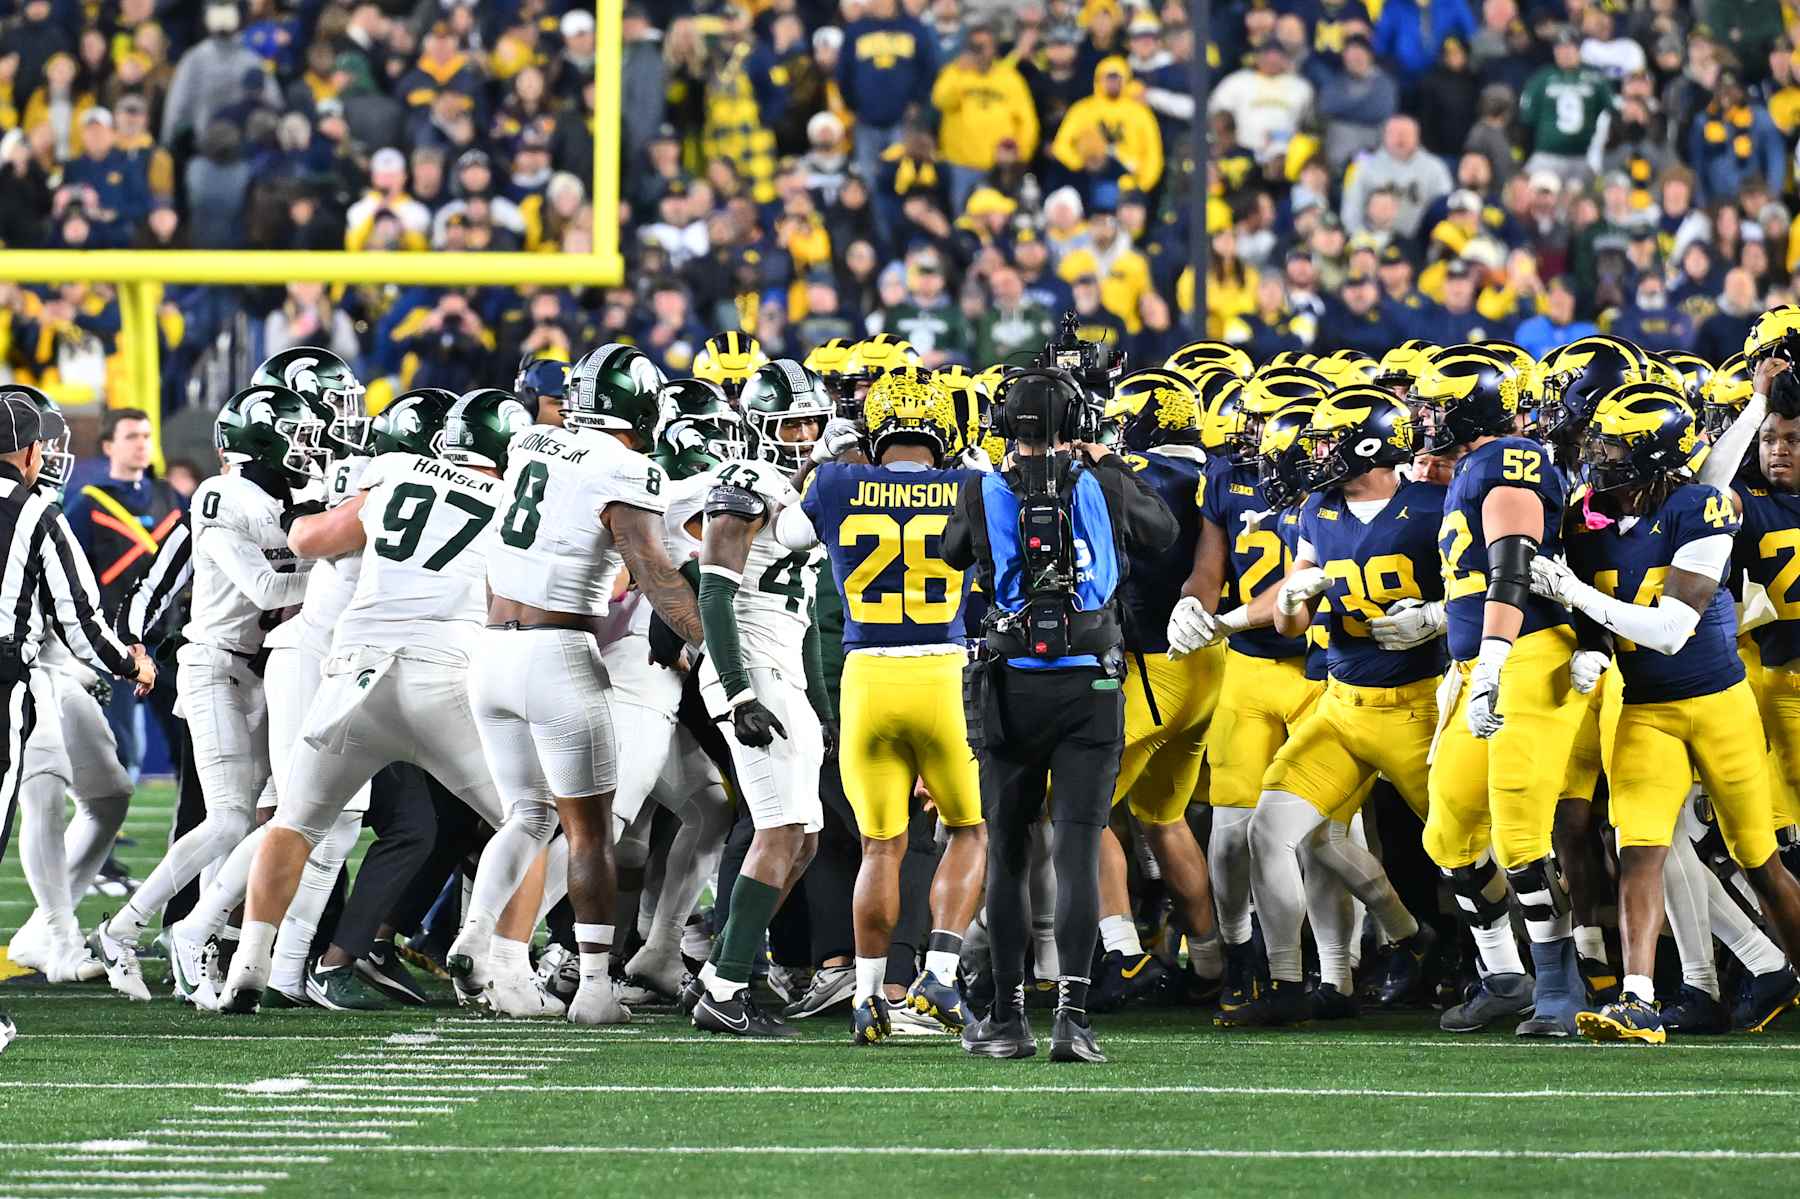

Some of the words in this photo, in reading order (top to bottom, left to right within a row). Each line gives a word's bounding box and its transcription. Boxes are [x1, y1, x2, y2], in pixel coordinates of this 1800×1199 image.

[442, 453, 469, 462] TANS
[518, 432, 567, 457] JONES
[561, 449, 591, 464] JR
[334, 466, 350, 494] 6
[412, 458, 495, 494] HANSEN
[646, 466, 662, 496] 8
[716, 464, 760, 491] 43
[1502, 448, 1542, 484] 52
[202, 491, 222, 520] 0
[500, 459, 550, 551] 8
[849, 480, 959, 508] JOHNSON
[374, 481, 497, 573] 97
[1703, 496, 1739, 529] 44
[838, 513, 965, 625] 28
[1234, 529, 1293, 605] 2
[1437, 510, 1488, 602] 2
[758, 551, 818, 614] 4
[1075, 571, 1094, 583] RK
[1323, 554, 1423, 638] 39
